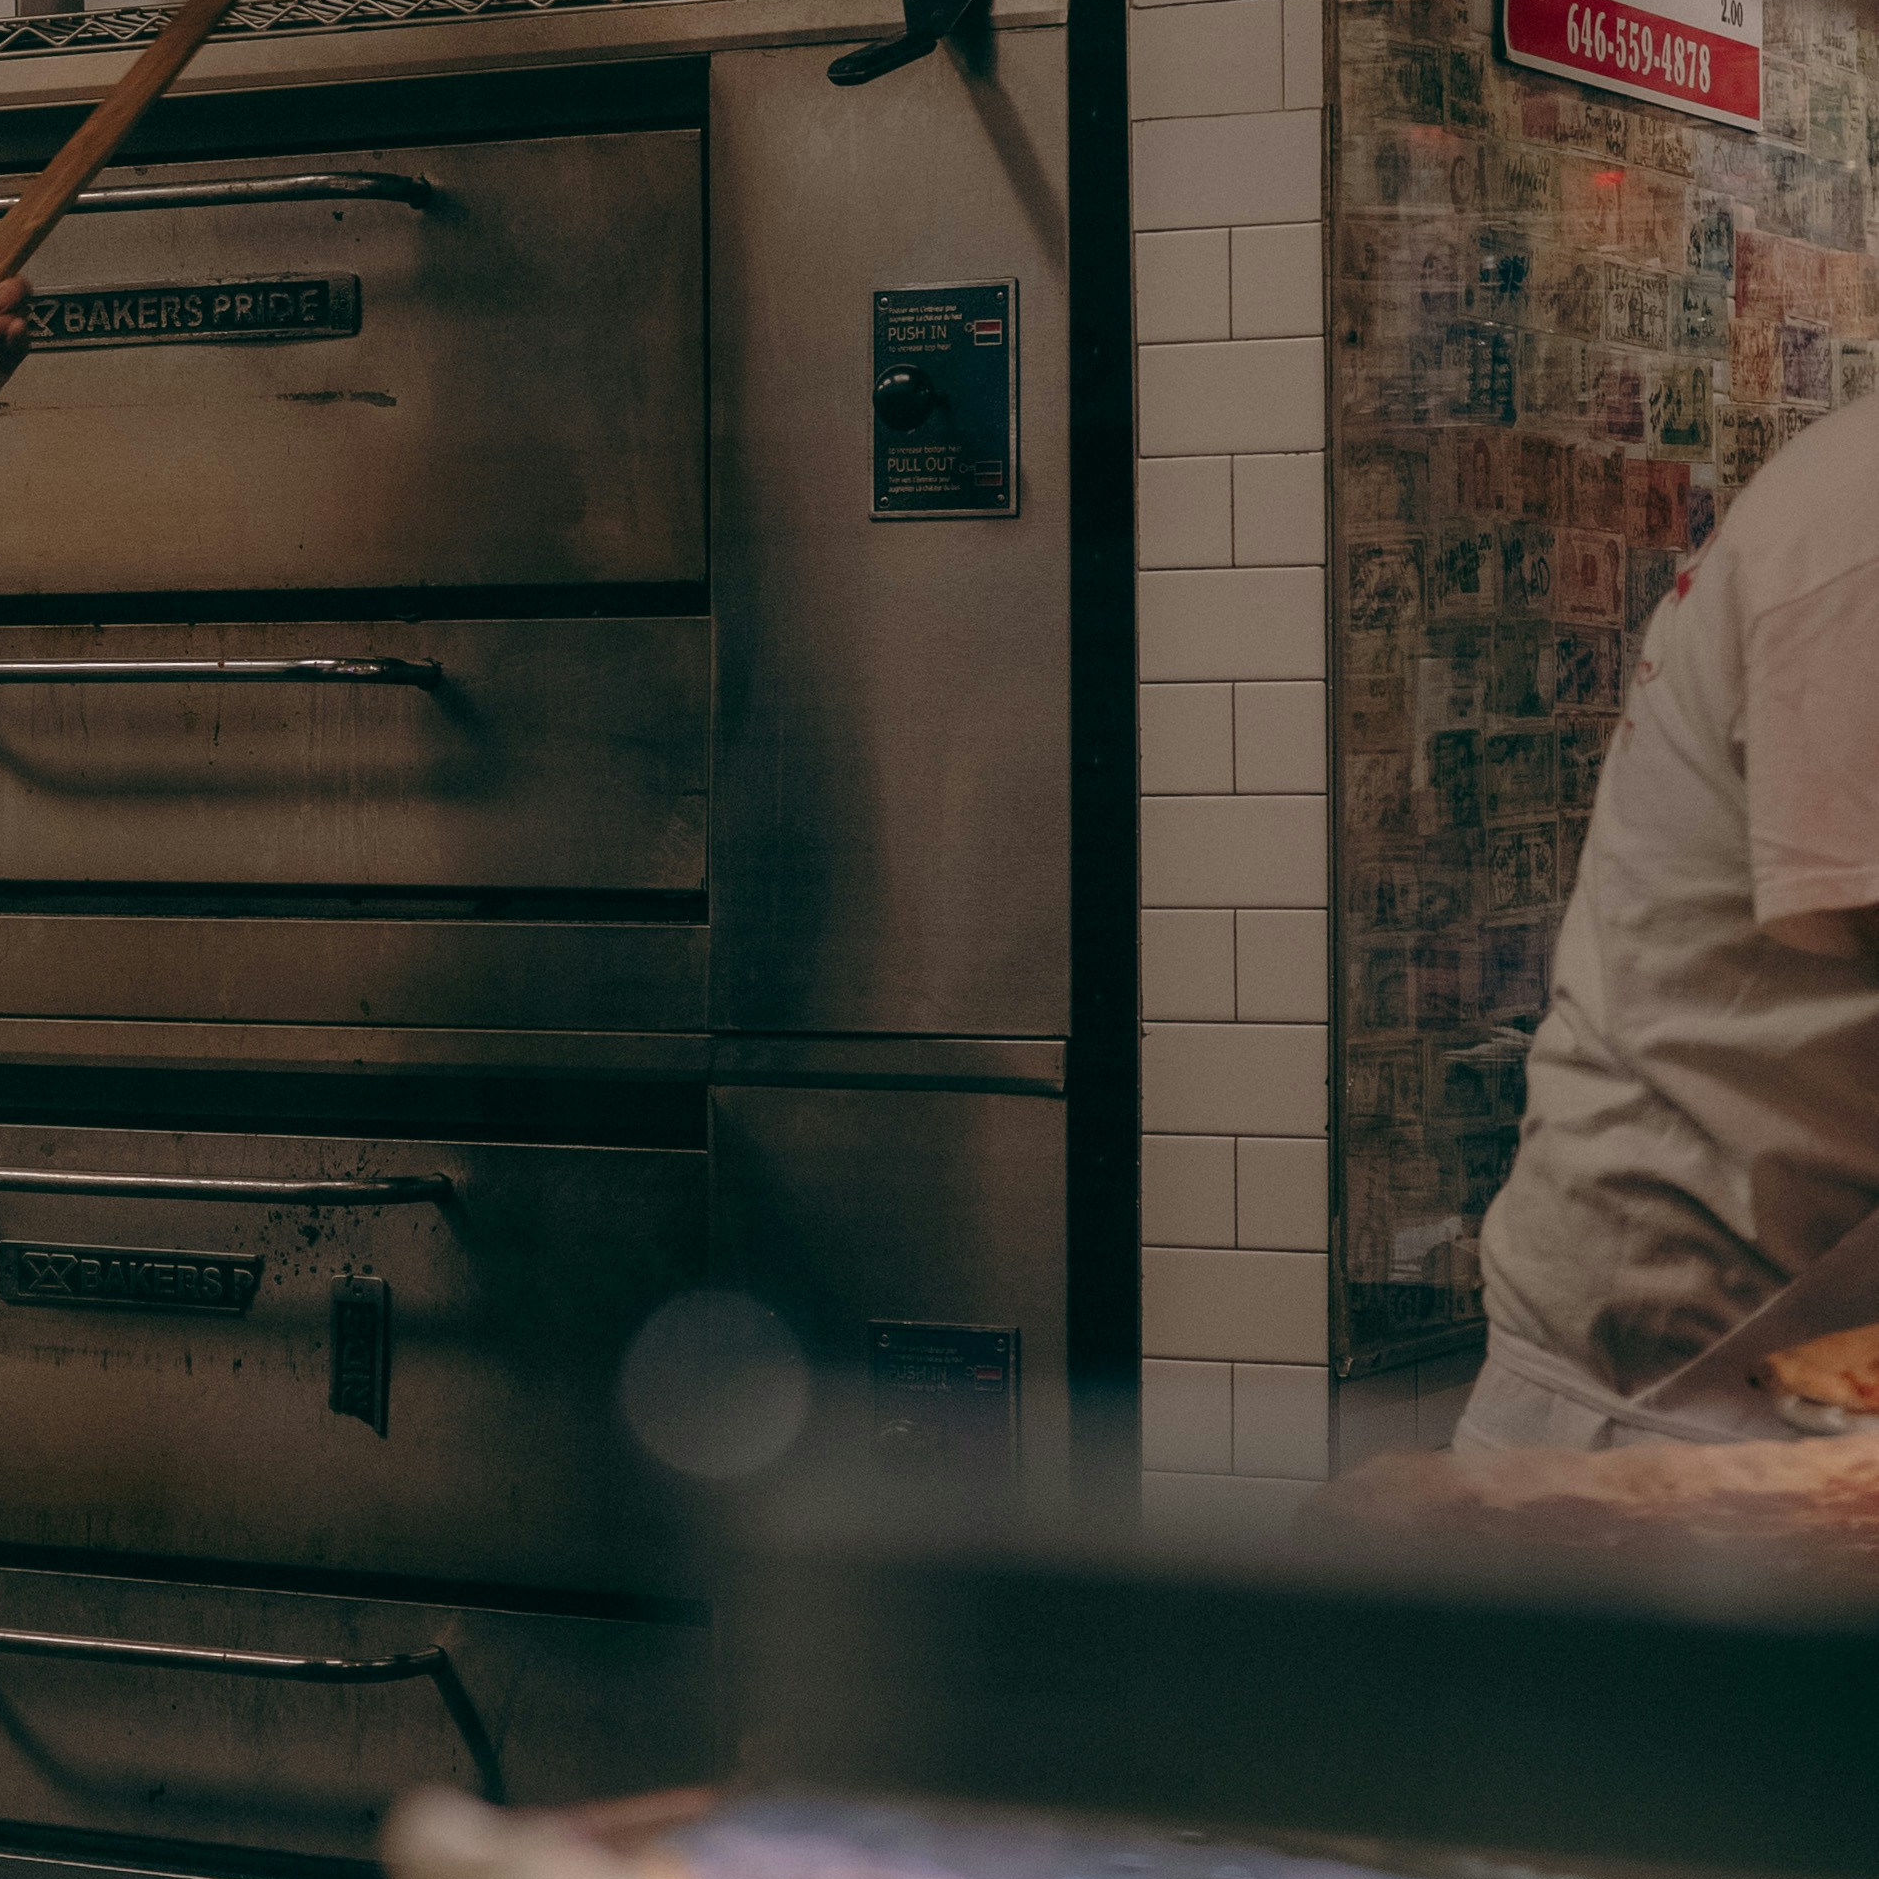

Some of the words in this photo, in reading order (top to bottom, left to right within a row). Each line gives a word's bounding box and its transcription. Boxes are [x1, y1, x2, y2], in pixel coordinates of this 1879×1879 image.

[1567, 2, 1712, 94] 646-559-4878
[63, 293, 205, 334] BAKERS
[211, 287, 319, 326] PRIDE
[888, 325, 926, 341] PUSH
[931, 324, 947, 340] IN
[887, 458, 922, 473] PULL
[925, 456, 956, 472] OUT
[79, 1257, 224, 1300] BAKERS
[232, 1267, 255, 1301] P
